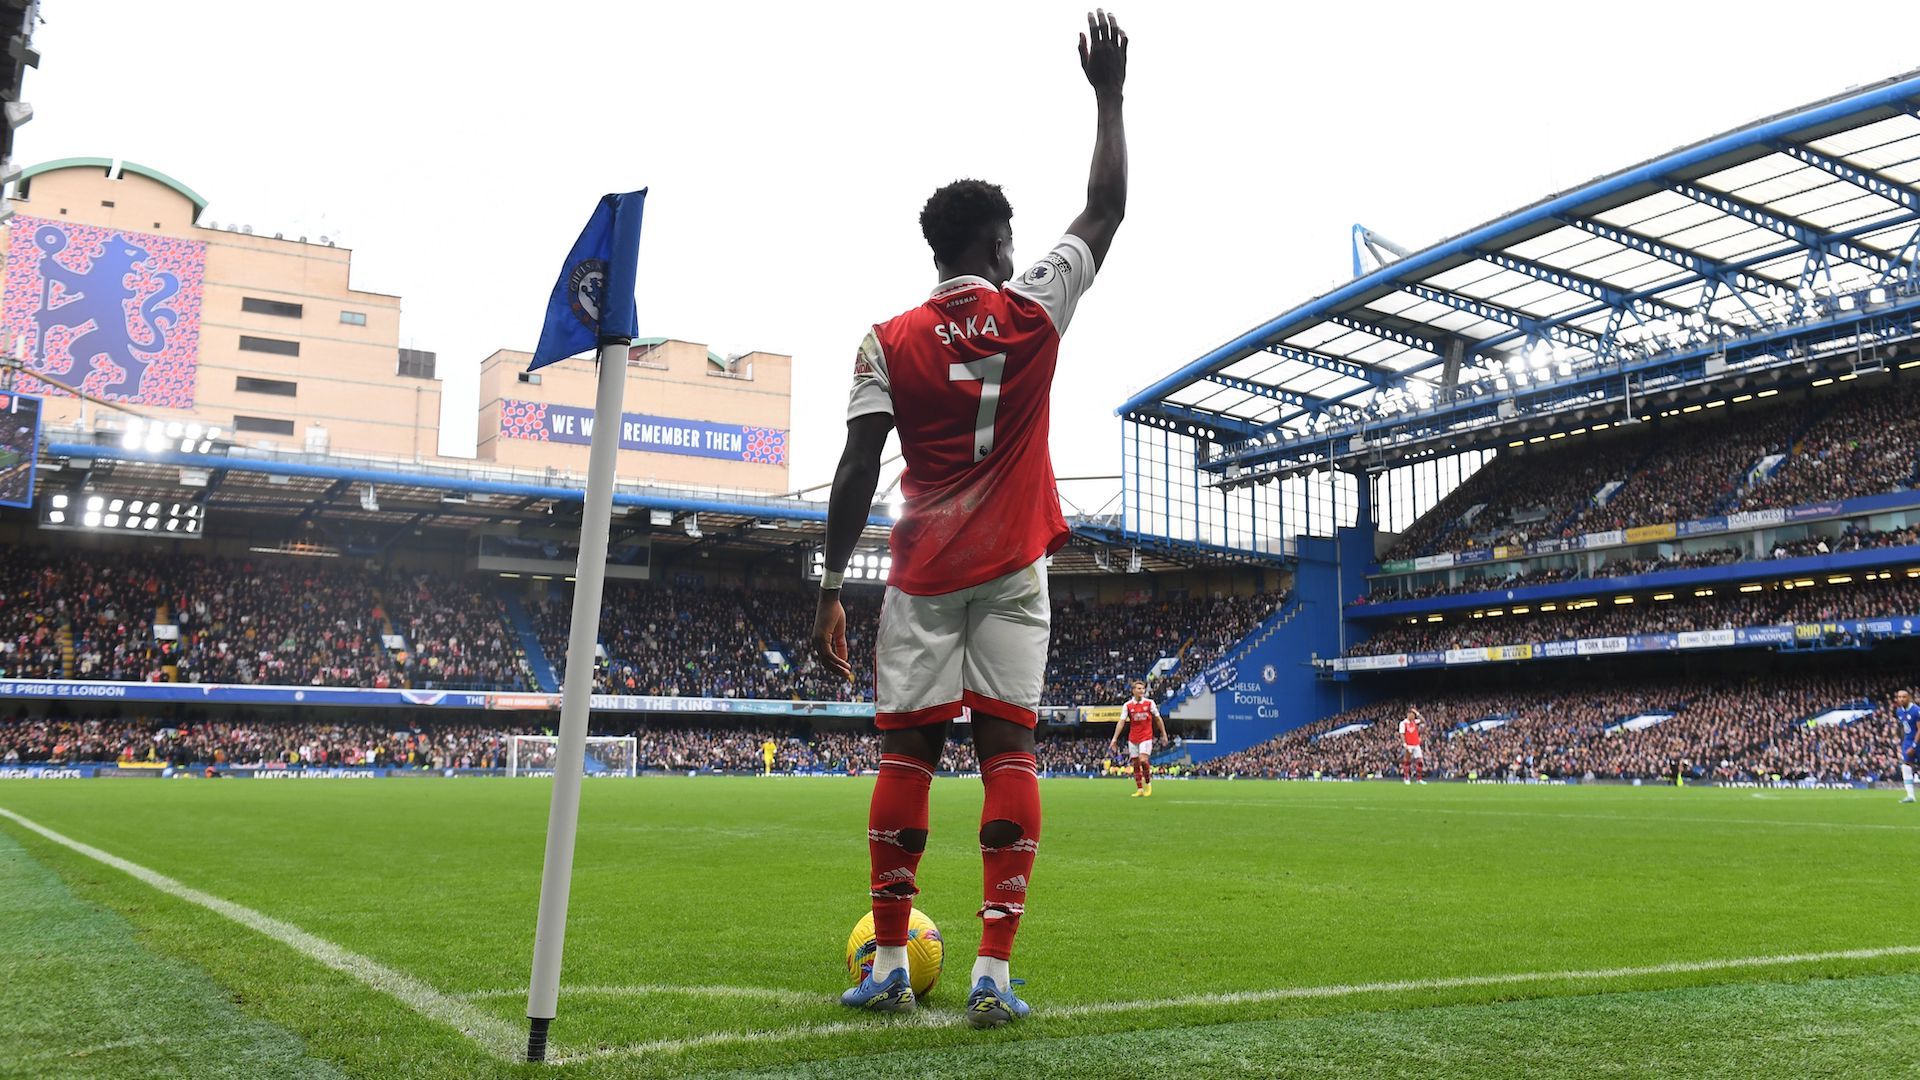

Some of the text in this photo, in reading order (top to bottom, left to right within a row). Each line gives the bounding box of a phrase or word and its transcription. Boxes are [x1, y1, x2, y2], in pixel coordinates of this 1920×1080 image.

[946, 295, 978, 309] ARSENAL
[934, 314, 1000, 345] SAKA
[949, 351, 1008, 463] 7
[552, 414, 574, 435] WE
[623, 422, 700, 448] REMEMBER
[705, 431, 742, 453] THEM
[1729, 512, 1758, 525] SOUTH
[1760, 508, 1785, 521] WEST
[1749, 632, 1793, 643] VANCOUVER
[1796, 624, 1820, 639] OHIO
[1584, 640, 1599, 650] YORK
[1601, 638, 1620, 648] BLUES
[0, 684, 13, 694] HE
[16, 684, 54, 695] PRIDE
[72, 686, 125, 697] LONDON
[465, 696, 485, 705] THE
[590, 697, 713, 711] ORN IS THE KING
[1234, 692, 1274, 705] FOOTBALL
[1258, 706, 1279, 718] CLUB
[254, 770, 375, 779] MATCH HIGHLIGHTS
[995, 883, 1027, 893] adidas
